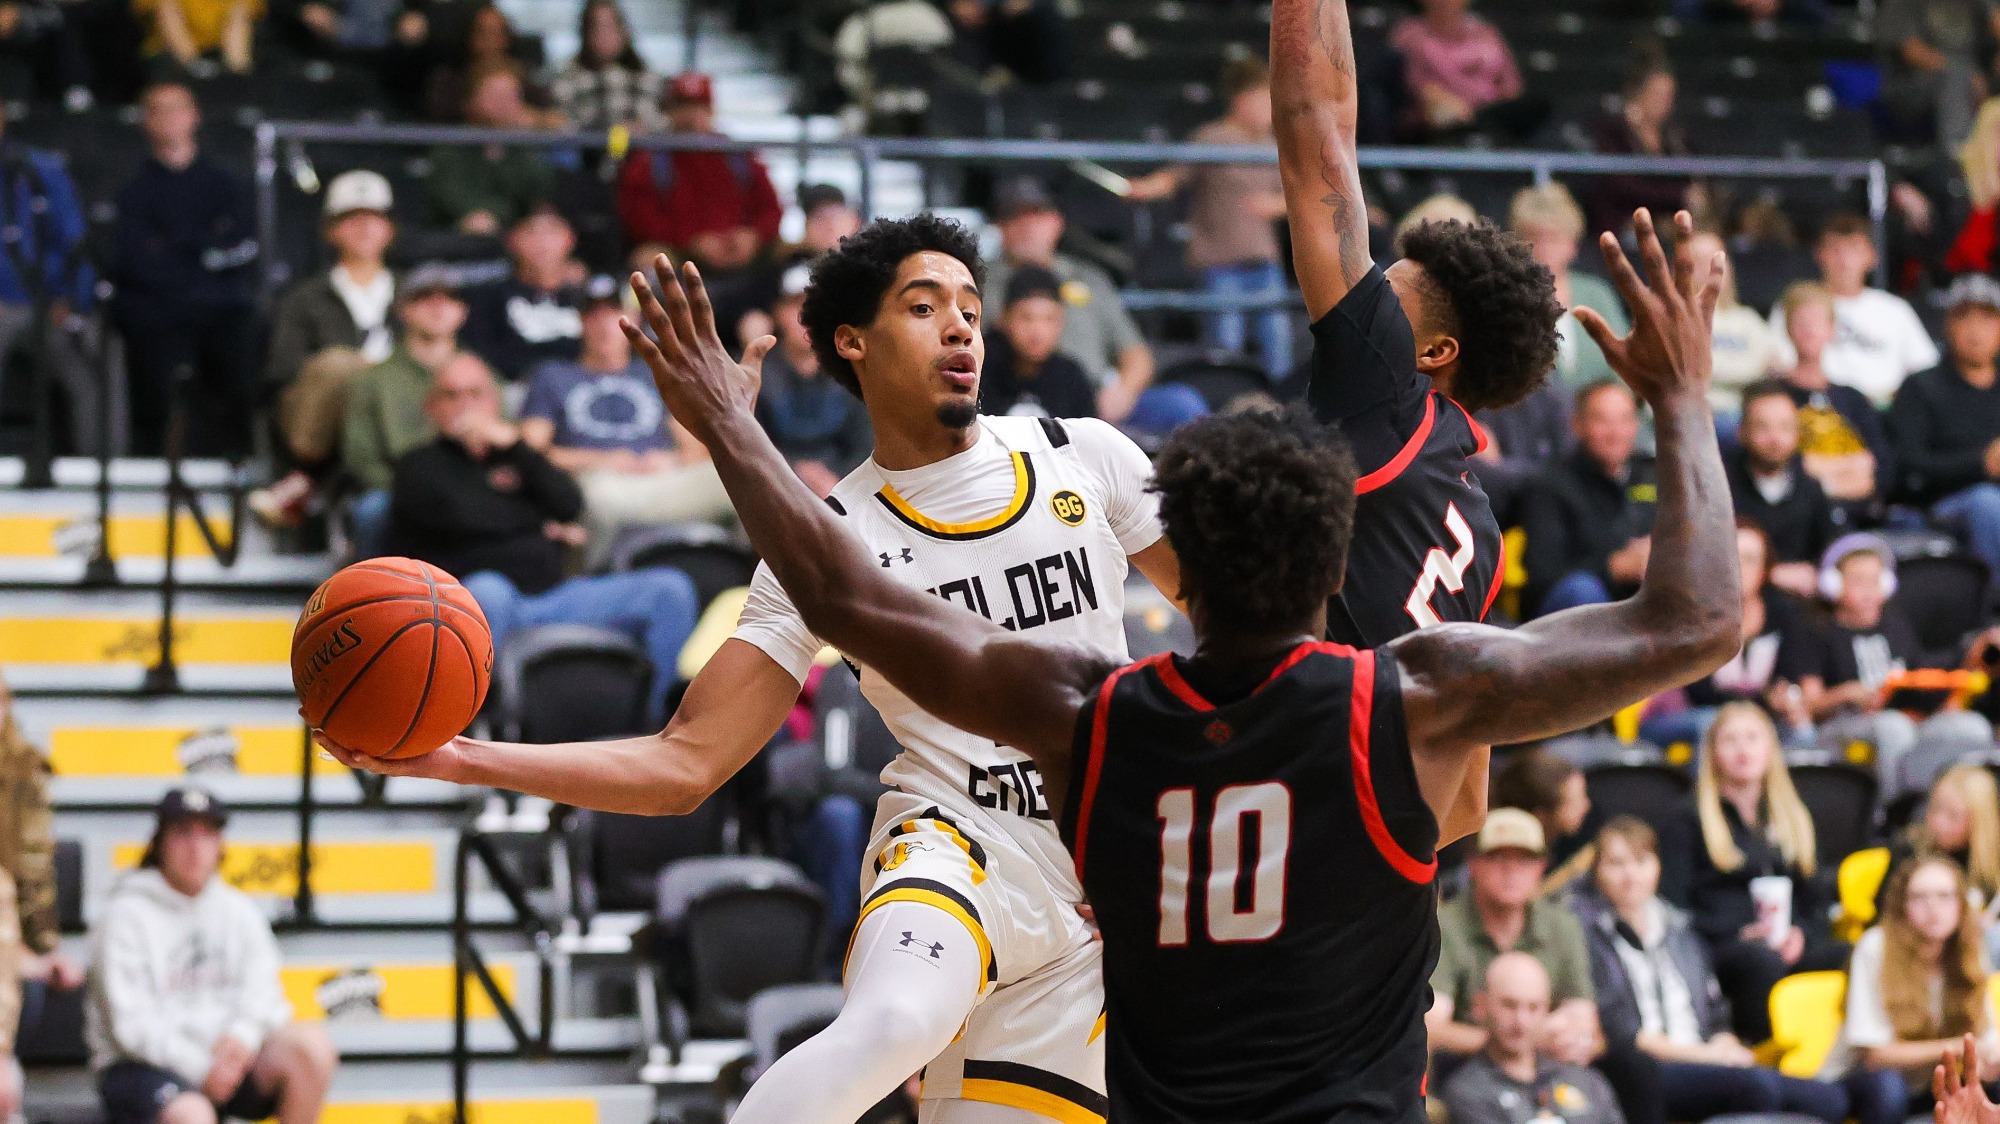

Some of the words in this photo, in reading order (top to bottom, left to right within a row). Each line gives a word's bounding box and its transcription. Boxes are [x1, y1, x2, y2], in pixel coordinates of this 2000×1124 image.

[1052, 494, 1084, 519] BG
[926, 546, 1098, 631] LDEN
[1403, 500, 1475, 629] 2
[1156, 780, 1294, 947] 10
